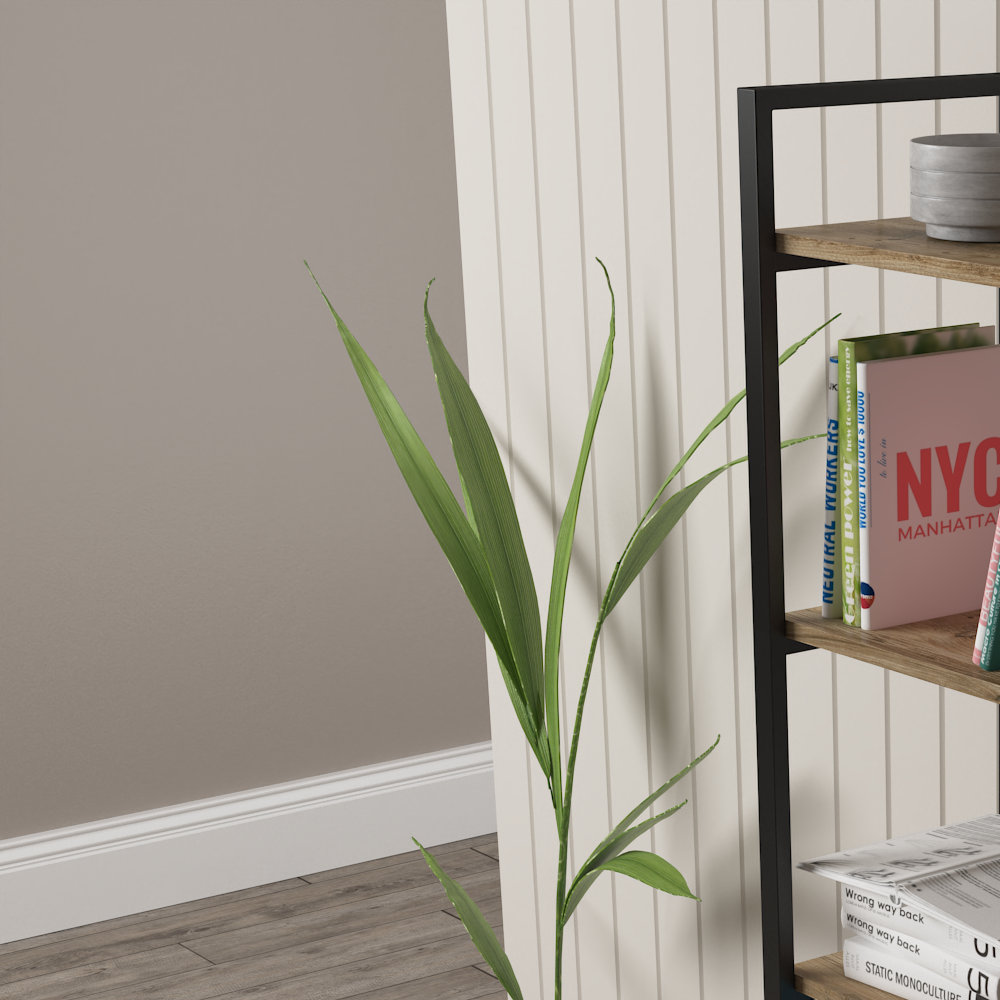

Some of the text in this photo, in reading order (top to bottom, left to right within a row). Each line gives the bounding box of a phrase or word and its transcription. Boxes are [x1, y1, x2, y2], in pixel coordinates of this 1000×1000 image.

[843, 455, 855, 539] power
[898, 512, 998, 542] MANHATTA
[845, 887, 875, 908] Wrong
[877, 901, 897, 916] way
[899, 907, 925, 925] back
[846, 913, 874, 934] Wrong
[876, 928, 895, 943] way
[896, 936, 921, 955] back
[865, 961, 894, 981] STATIC
